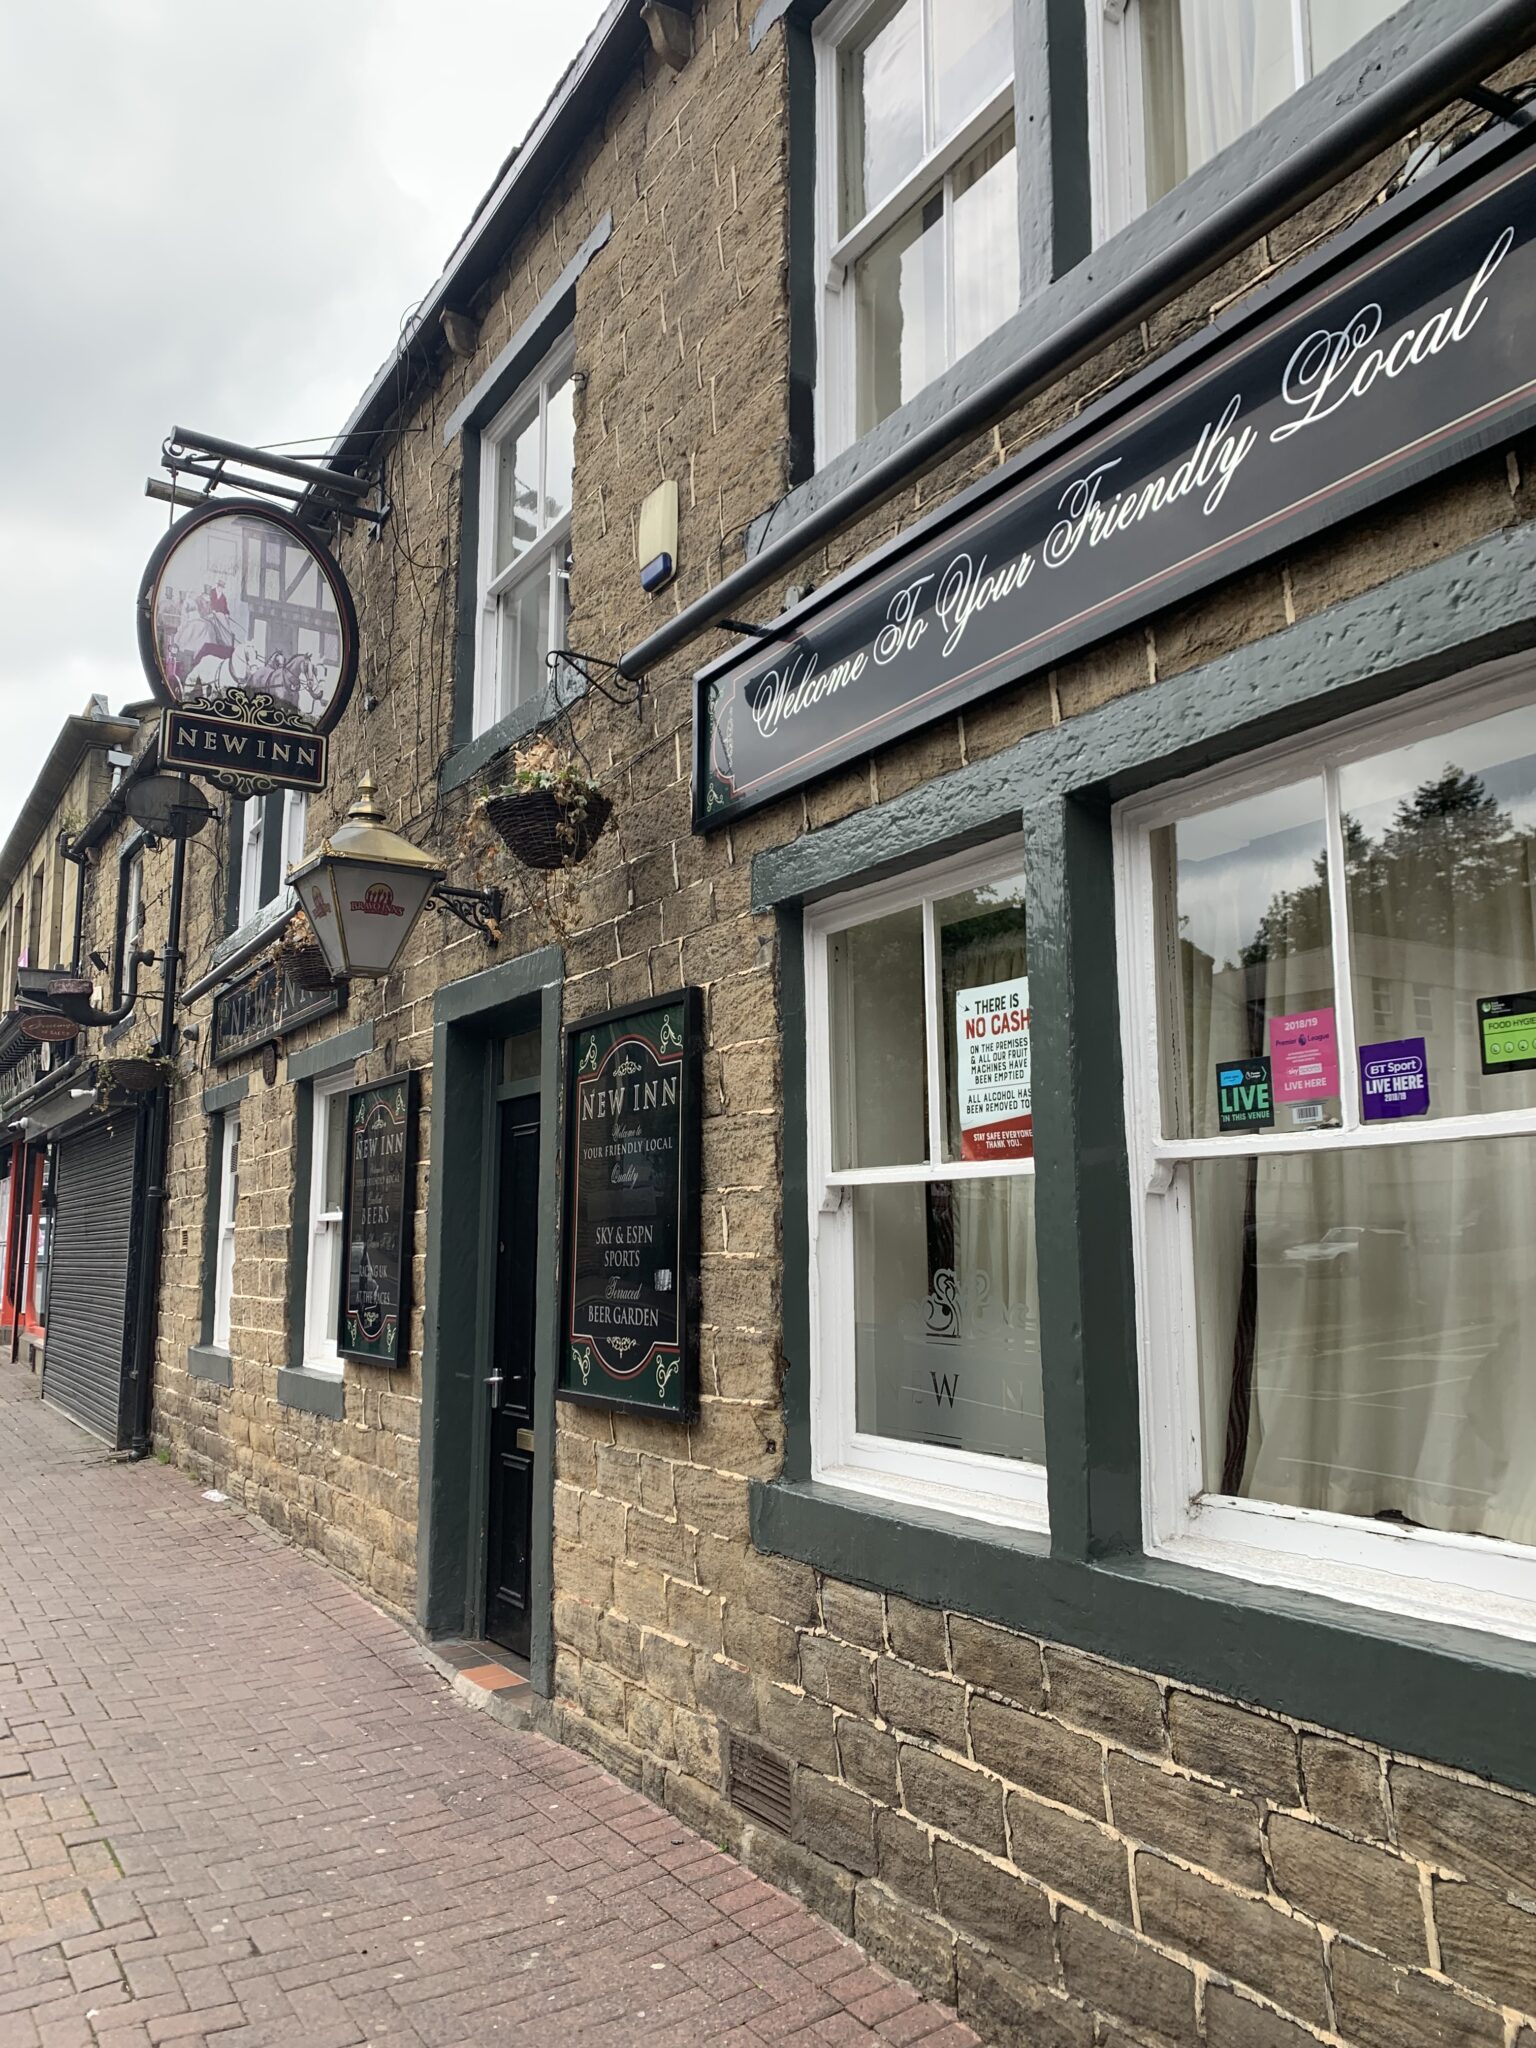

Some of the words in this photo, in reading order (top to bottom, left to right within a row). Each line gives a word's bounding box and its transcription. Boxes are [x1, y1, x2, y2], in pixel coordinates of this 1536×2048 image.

[751, 651, 869, 738] Welcome
[873, 573, 935, 665] To
[935, 553, 1036, 658] Your
[1042, 393, 1258, 568] Friendly
[1269, 225, 1515, 443] Local
[176, 726, 248, 755] NEW
[256, 740, 316, 766] INN
[974, 995, 1006, 1015] THERE
[1009, 993, 1020, 1009] IS
[965, 1016, 986, 1040] NO
[991, 1008, 1031, 1036] CASH
[1284, 1017, 1318, 1031] 2018/19
[1488, 1020, 1511, 1030] FOOD
[970, 1044, 980, 1054] ON
[981, 1042, 994, 1053] THE
[995, 1036, 1029, 1051] PREMISES
[970, 1055, 976, 1065] &
[978, 1053, 991, 1063] ALL
[992, 1050, 1006, 1062] OUR
[1008, 1047, 1028, 1060] FRUIT
[971, 1061, 1007, 1075] MACHINES
[1008, 1060, 1028, 1070] HAVE
[974, 1073, 992, 1085] BEEN
[994, 1069, 1025, 1082] EMPTIED
[1370, 1064, 1387, 1075] BT
[1387, 1060, 1417, 1074] Sport
[1284, 1080, 1303, 1091] LIVE
[1304, 1077, 1328, 1089] HERE
[1365, 1078, 1392, 1095] LIVE
[1392, 1074, 1425, 1092] HERE
[581, 1087, 626, 1121] NEW
[633, 1076, 677, 1111] INN
[968, 1094, 981, 1104] ALL
[983, 1090, 1016, 1102] ALCOHOL
[1017, 1088, 1031, 1099] HAS
[1221, 1083, 1270, 1113] LIVE
[966, 1103, 983, 1115] BEEN
[985, 1100, 1018, 1113] REMOVED
[1021, 1099, 1031, 1109] TO
[1231, 1112, 1247, 1121] THIS
[1247, 1110, 1271, 1120] VENUE
[611, 1123, 635, 1142] Welcome
[973, 1132, 985, 1142] STAY
[986, 1131, 1001, 1141] SAFE
[1001, 1129, 1033, 1140] EVERYONE
[355, 1137, 379, 1160] NEW
[380, 1132, 404, 1156] INN
[583, 1146, 603, 1161] YOUR
[605, 1142, 643, 1159] FRIENDLY
[645, 1136, 673, 1153] LOCAL
[986, 1139, 1005, 1149] THANK
[611, 1163, 639, 1190] Quality
[361, 1205, 390, 1225] BEERS
[595, 1226, 614, 1245] SKY
[615, 1226, 624, 1244] &
[626, 1224, 654, 1244] ESPN
[604, 1249, 640, 1268] SPORTS
[605, 1275, 643, 1300] Terraced
[588, 1305, 612, 1325] BEER
[613, 1305, 659, 1327] GARDEN
